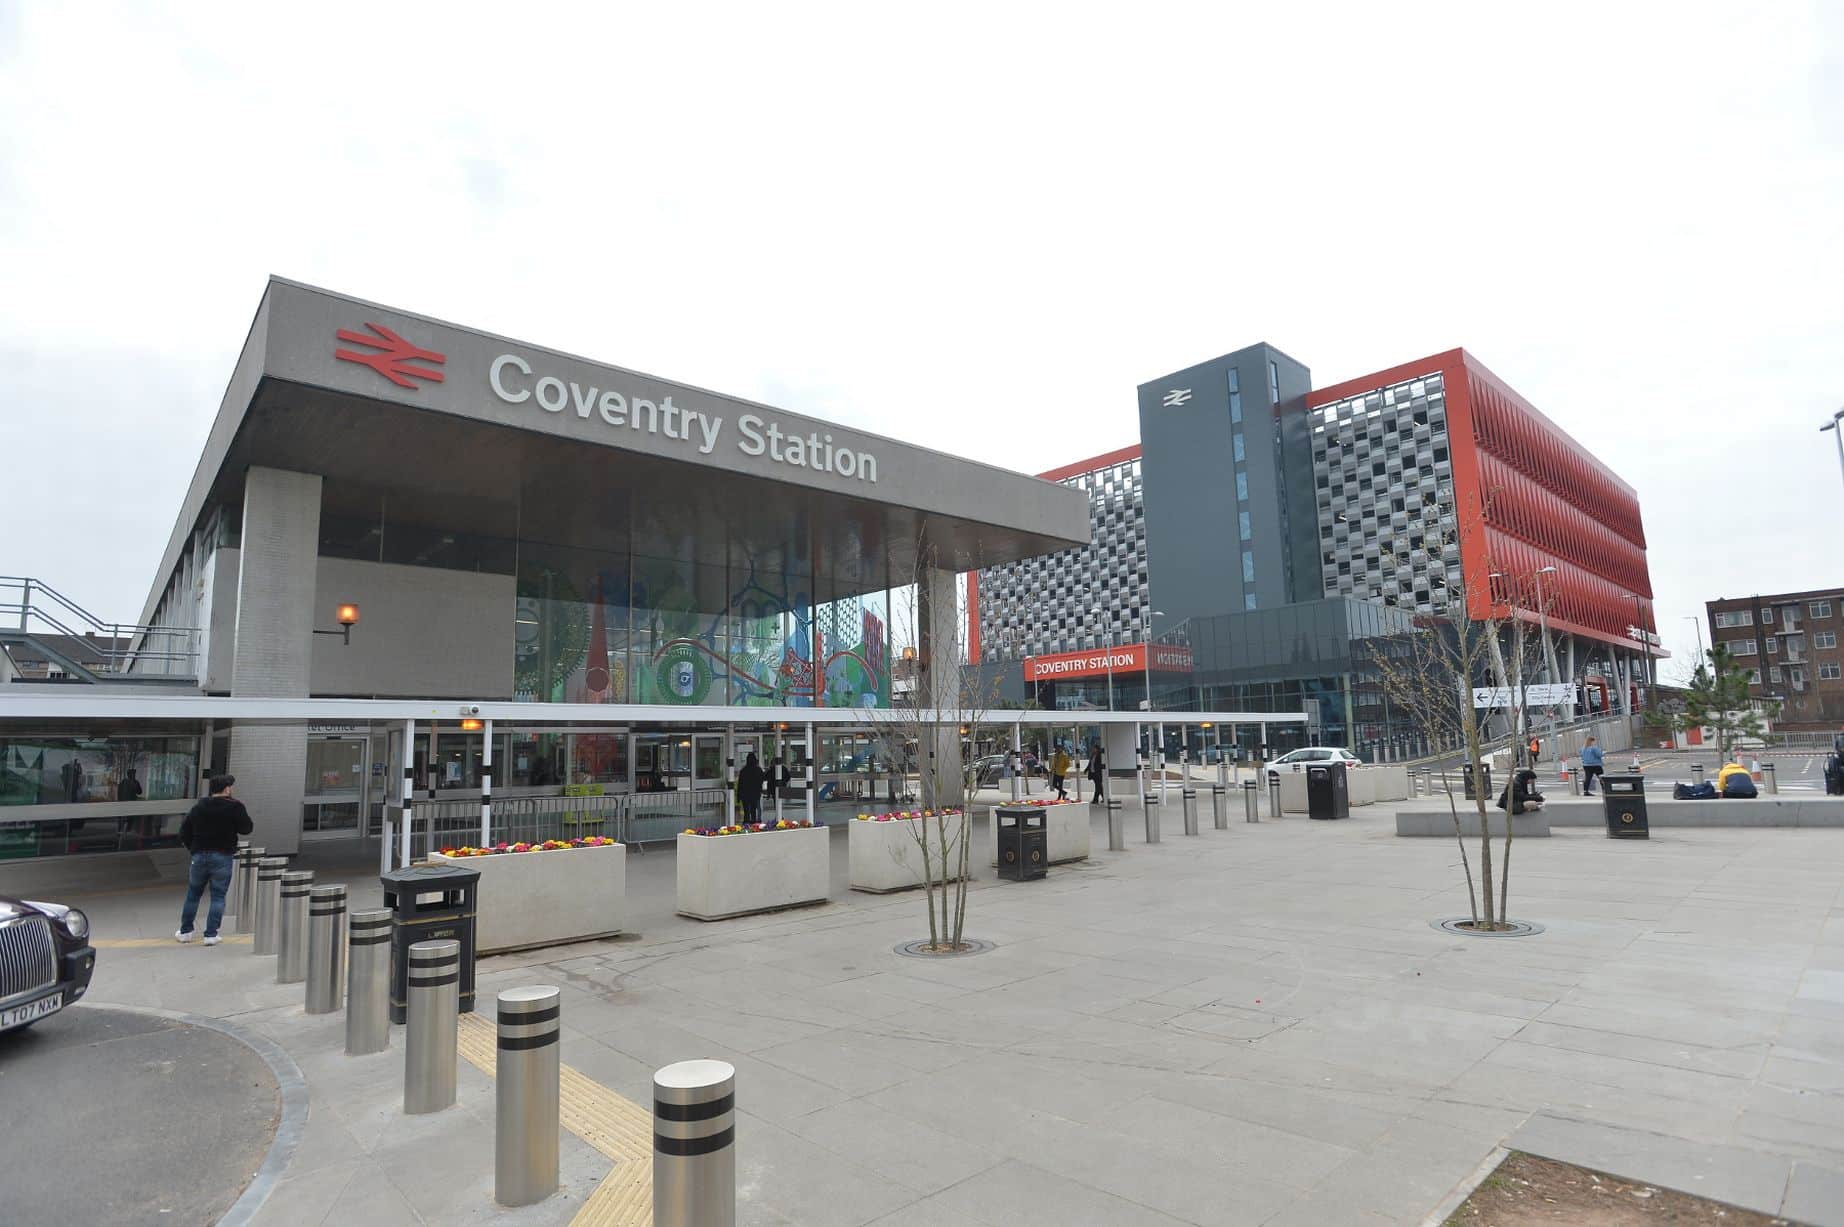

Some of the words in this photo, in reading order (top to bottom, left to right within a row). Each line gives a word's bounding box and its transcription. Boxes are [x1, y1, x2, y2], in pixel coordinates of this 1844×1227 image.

[489, 354, 722, 454] Coventry
[738, 414, 877, 483] Station
[1036, 659, 1087, 674] COVENTRY
[1089, 654, 1134, 669] STATION
[1, 1003, 35, 1026] LT07
